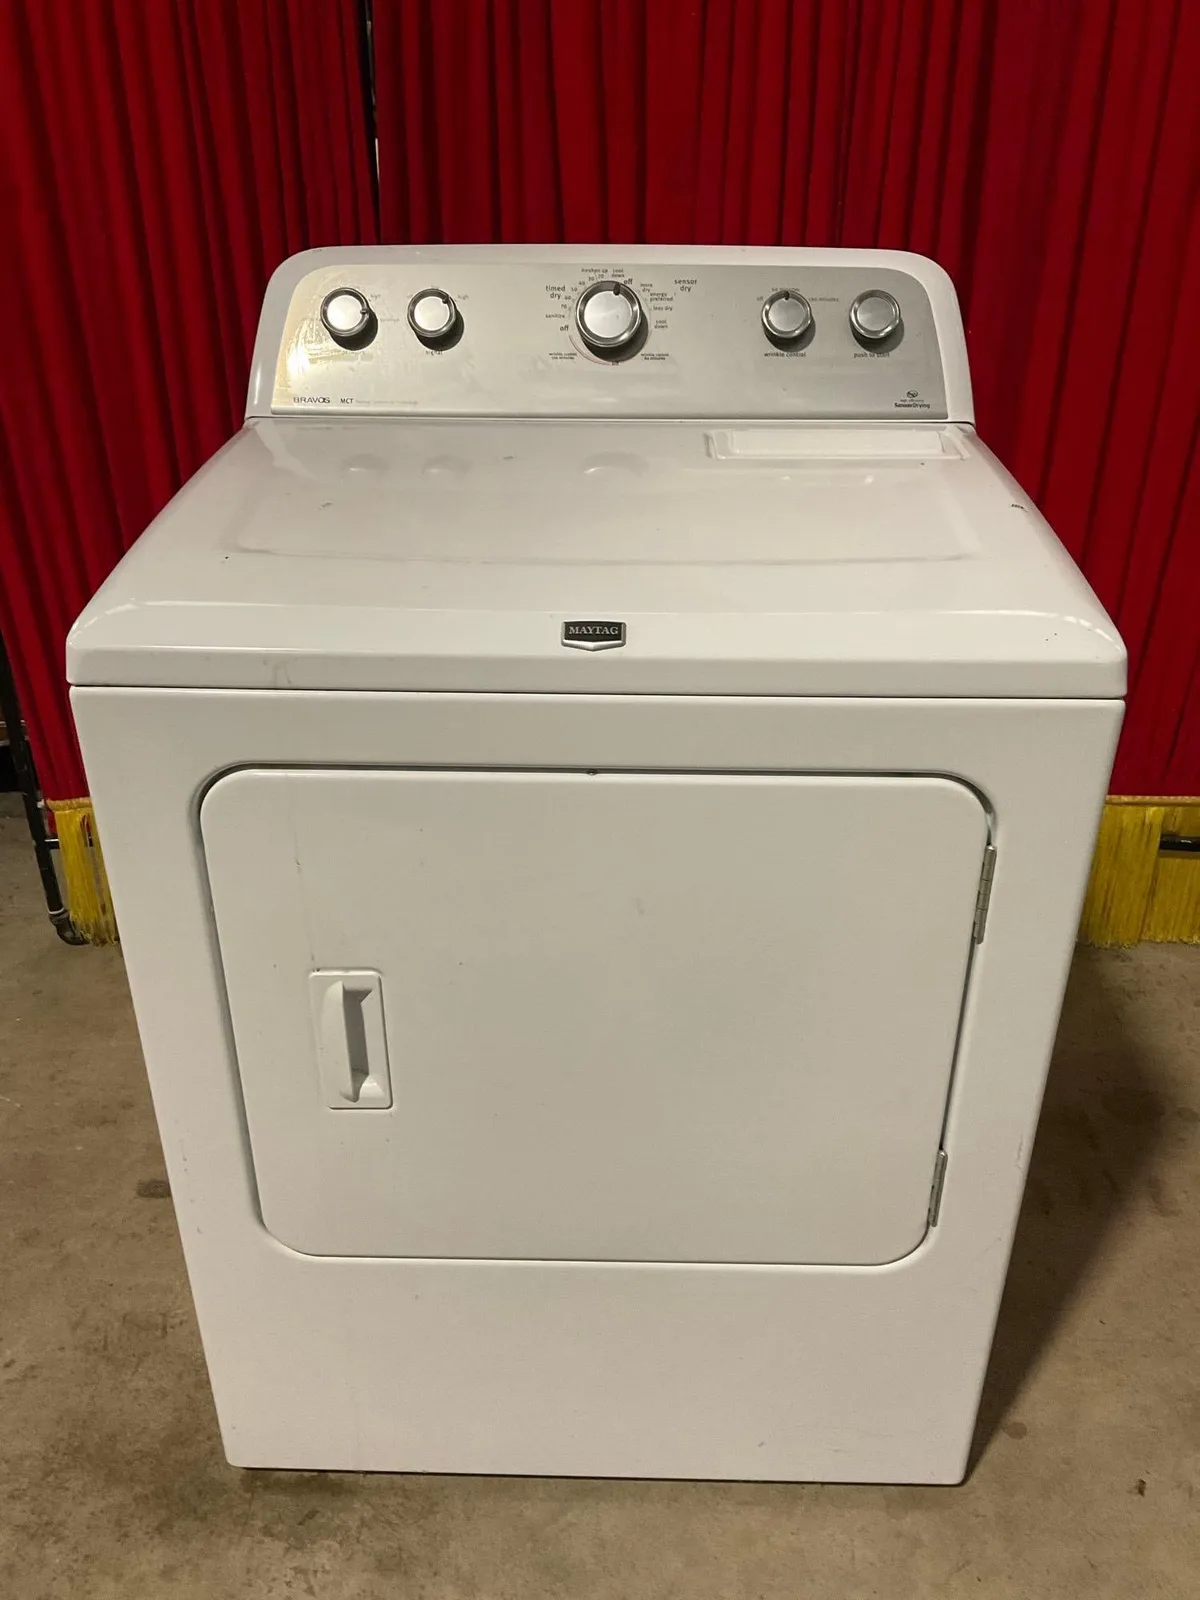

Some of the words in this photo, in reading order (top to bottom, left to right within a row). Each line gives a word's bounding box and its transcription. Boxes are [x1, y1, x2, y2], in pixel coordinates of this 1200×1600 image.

[545, 284, 566, 292] timed
[680, 285, 692, 293] dry
[550, 292, 562, 300] dry
[293, 396, 331, 404] BRAVOS
[568, 626, 619, 635] MAYTAG
